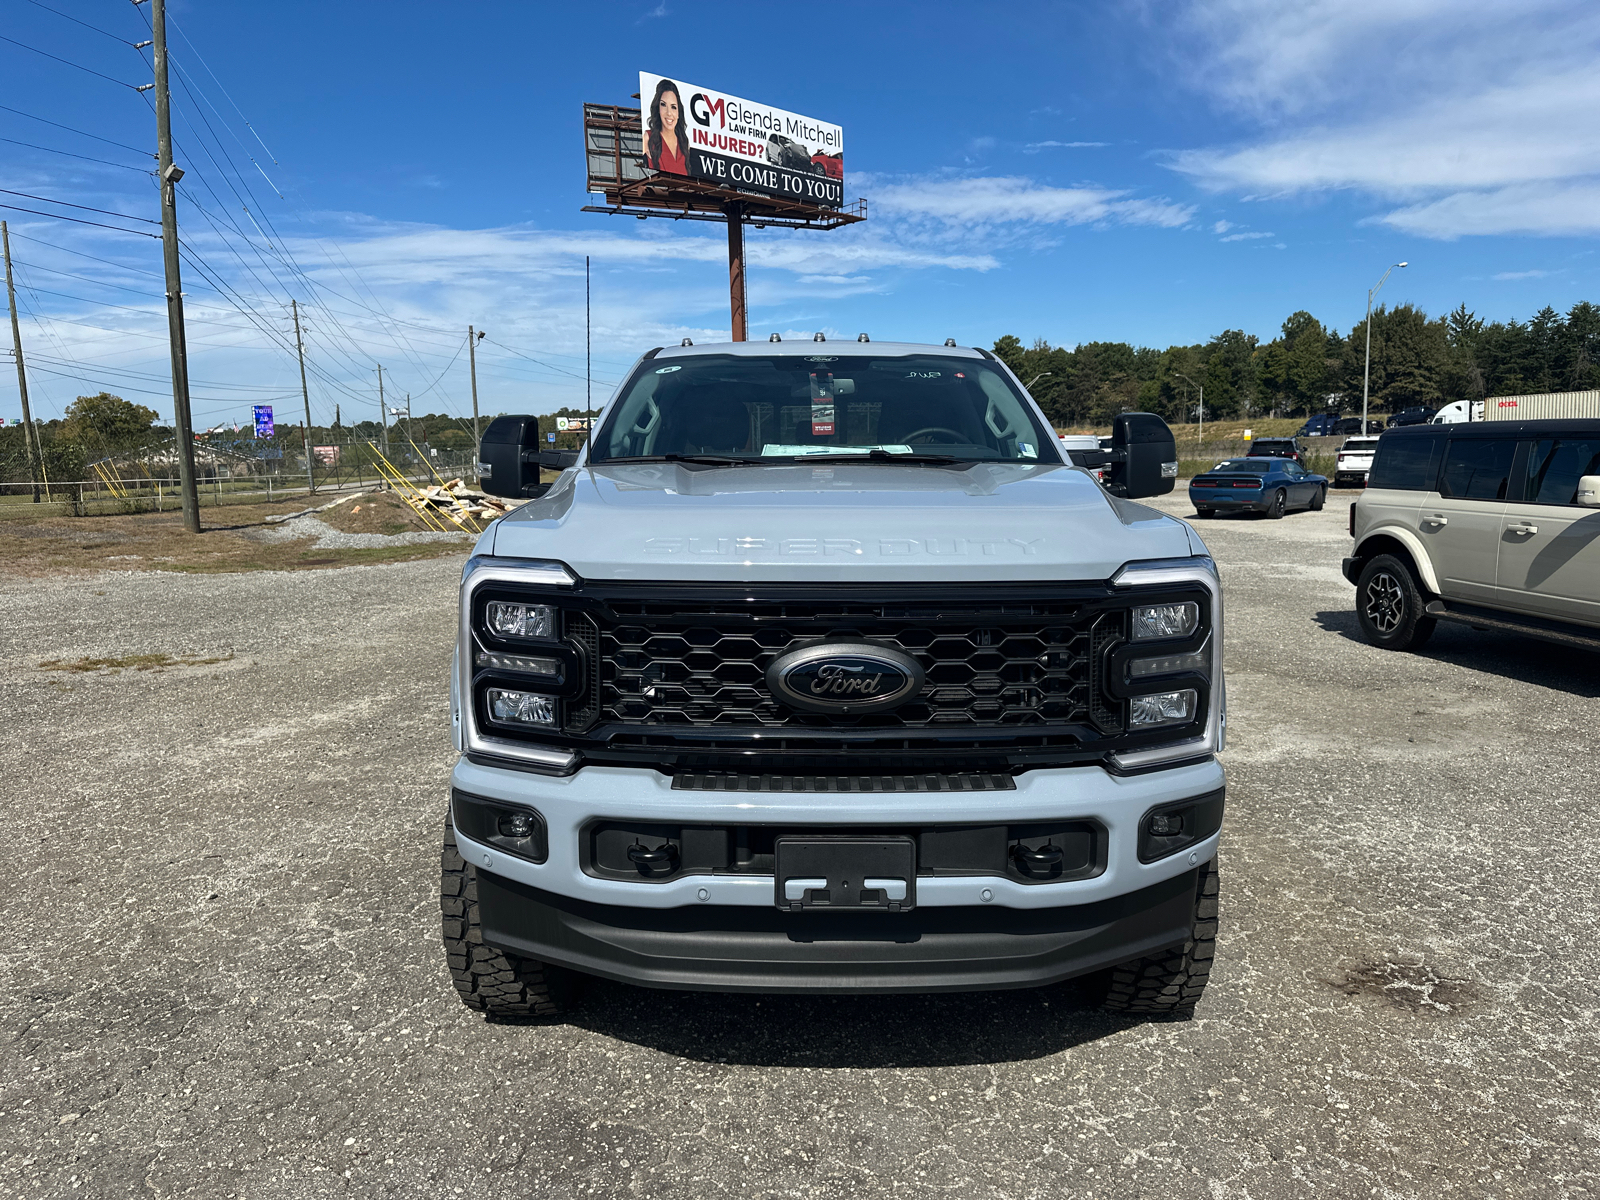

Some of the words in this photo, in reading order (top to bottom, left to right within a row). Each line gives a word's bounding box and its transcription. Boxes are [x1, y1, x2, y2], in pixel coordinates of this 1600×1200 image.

[726, 102, 781, 132] Glenda
[786, 117, 841, 148] Mitchell
[729, 122, 747, 135] LAW
[748, 128, 767, 140] FIRM
[692, 128, 764, 158] INJURED?
[699, 155, 727, 178] WE
[730, 163, 778, 189] COME
[781, 173, 803, 194] TO
[805, 179, 840, 202] YOU!
[643, 537, 863, 556] SUPER
[878, 537, 1047, 556] DUTY
[810, 664, 882, 694] Ford
